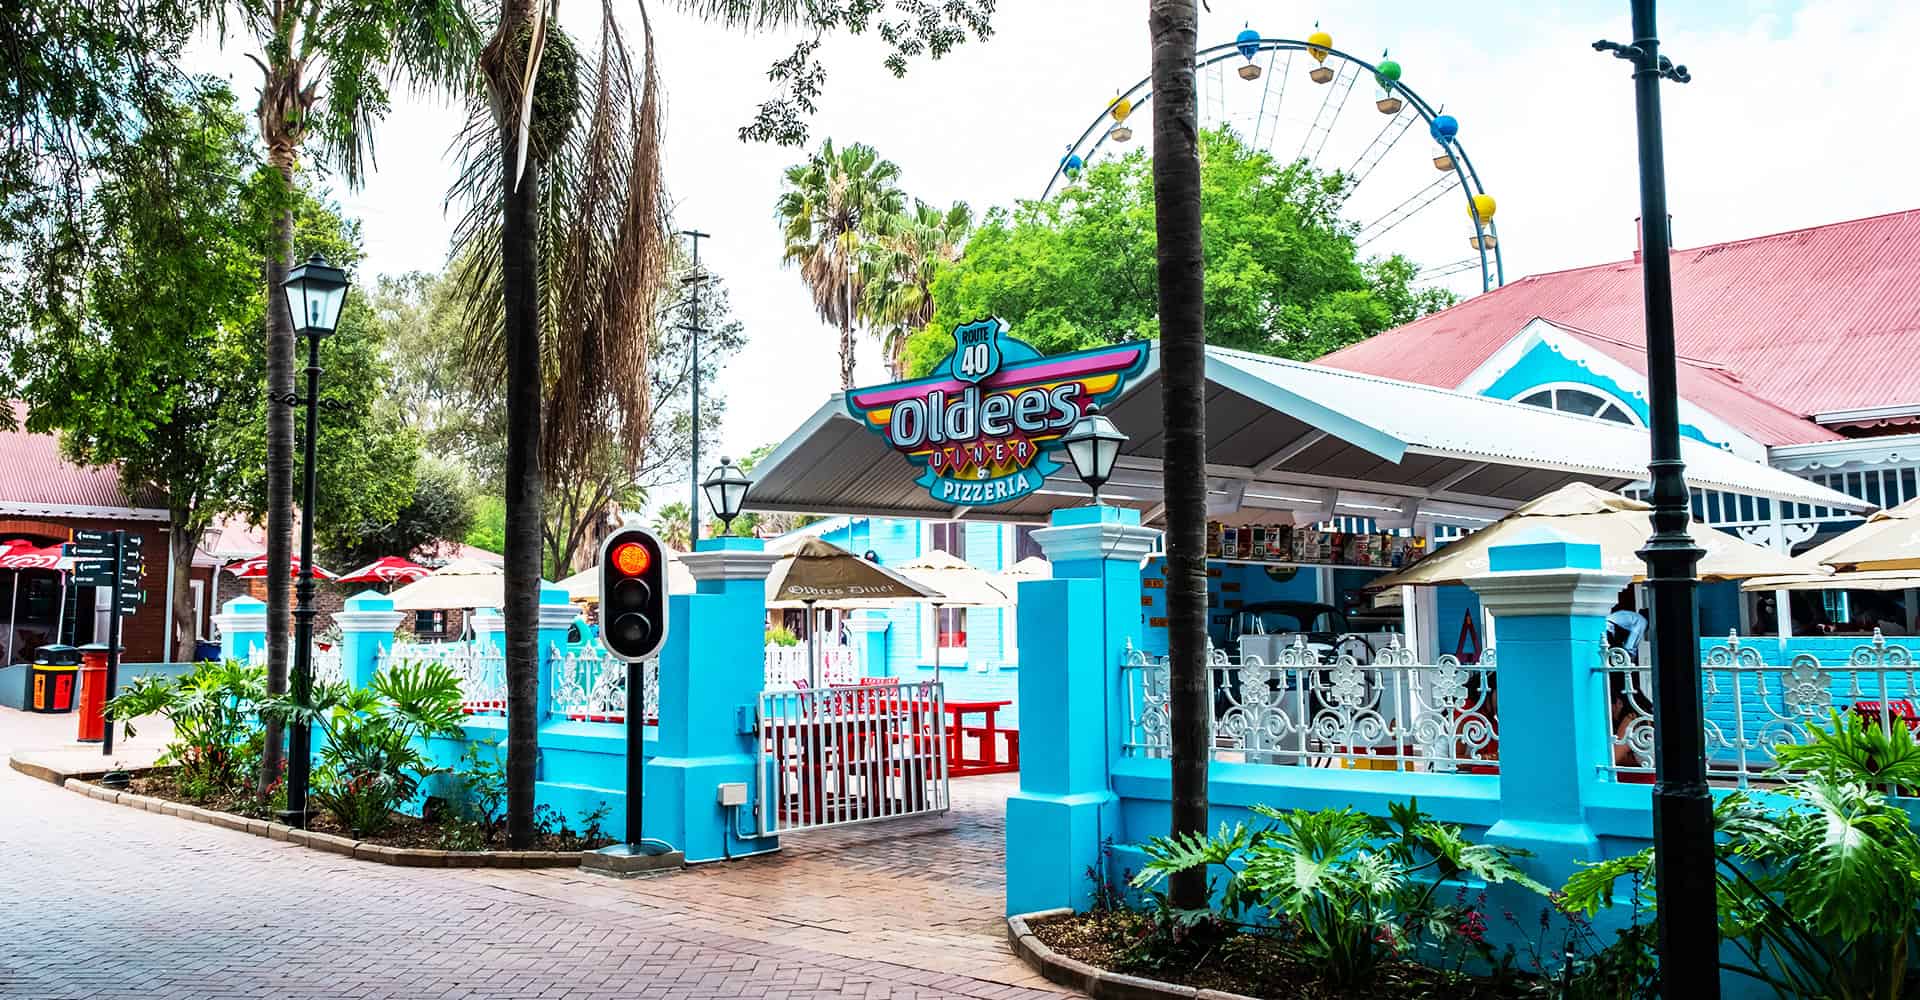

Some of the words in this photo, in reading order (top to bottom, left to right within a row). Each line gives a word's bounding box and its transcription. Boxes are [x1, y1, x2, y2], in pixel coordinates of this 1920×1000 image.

[962, 327, 989, 344] ROUTE
[961, 343, 988, 376] 40
[889, 383, 1082, 448] Oldees
[934, 442, 1027, 467] DINER
[943, 474, 1030, 501] PIZZERIA
[848, 584, 895, 594] Diner
